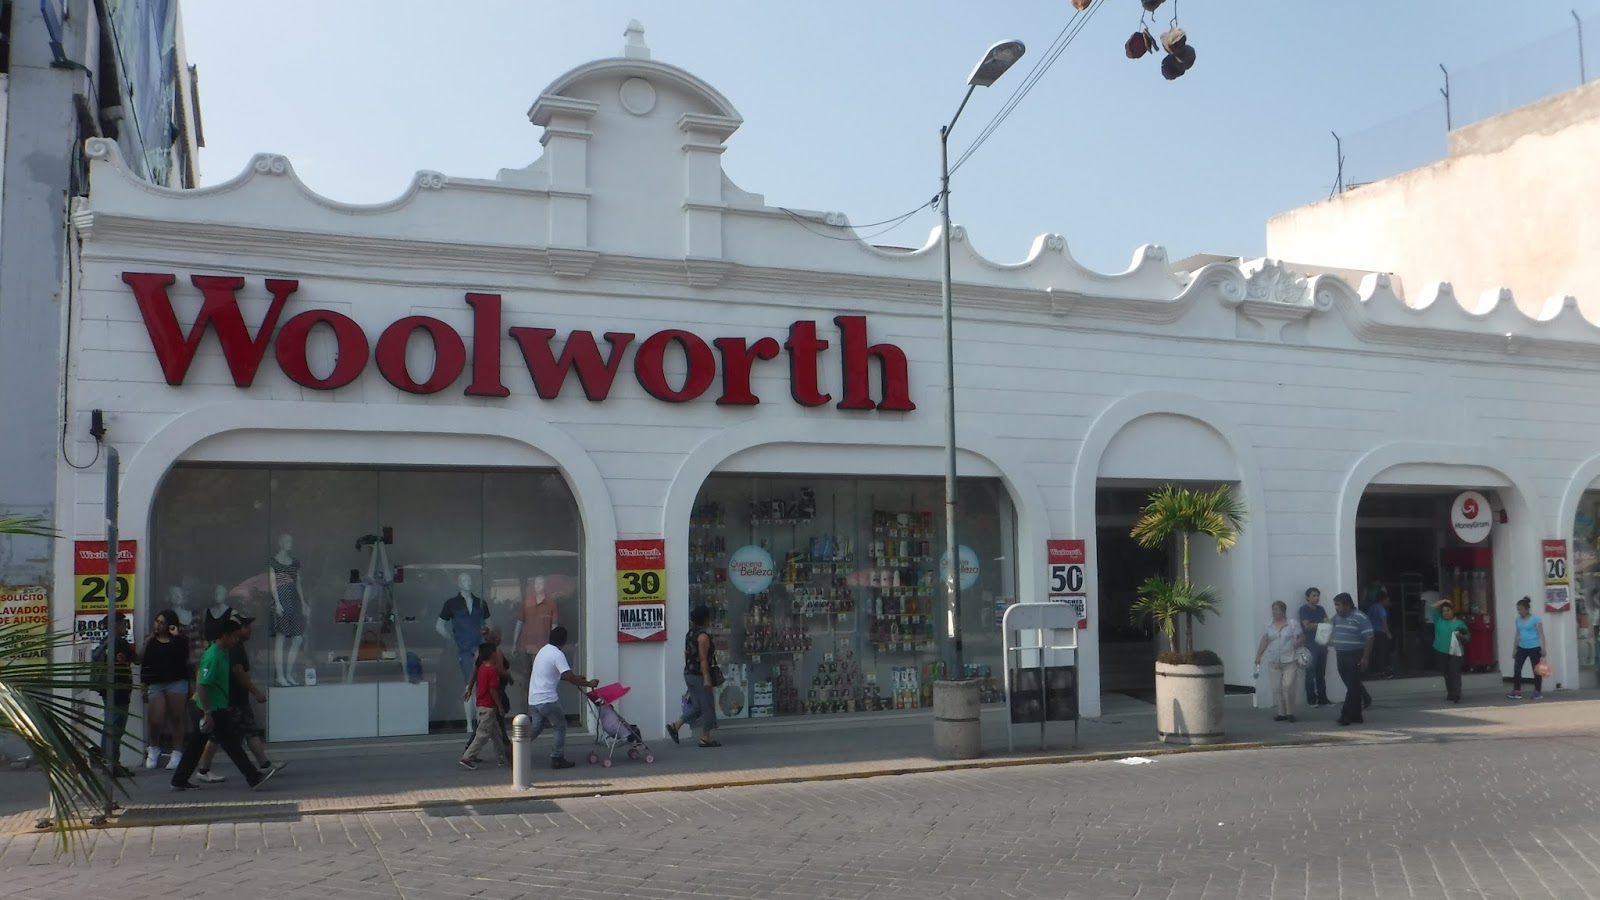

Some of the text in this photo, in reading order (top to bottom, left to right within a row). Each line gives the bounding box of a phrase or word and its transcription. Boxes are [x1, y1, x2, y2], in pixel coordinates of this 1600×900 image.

[122, 272, 916, 411] Woolworth
[1455, 521, 1489, 529] MoneyGram
[740, 566, 772, 576] Belleza
[0, 593, 43, 602] SOLICITO
[0, 606, 47, 615] AVADOR
[620, 608, 663, 622] MALETIN
[14, 615, 47, 624] AUTOS
